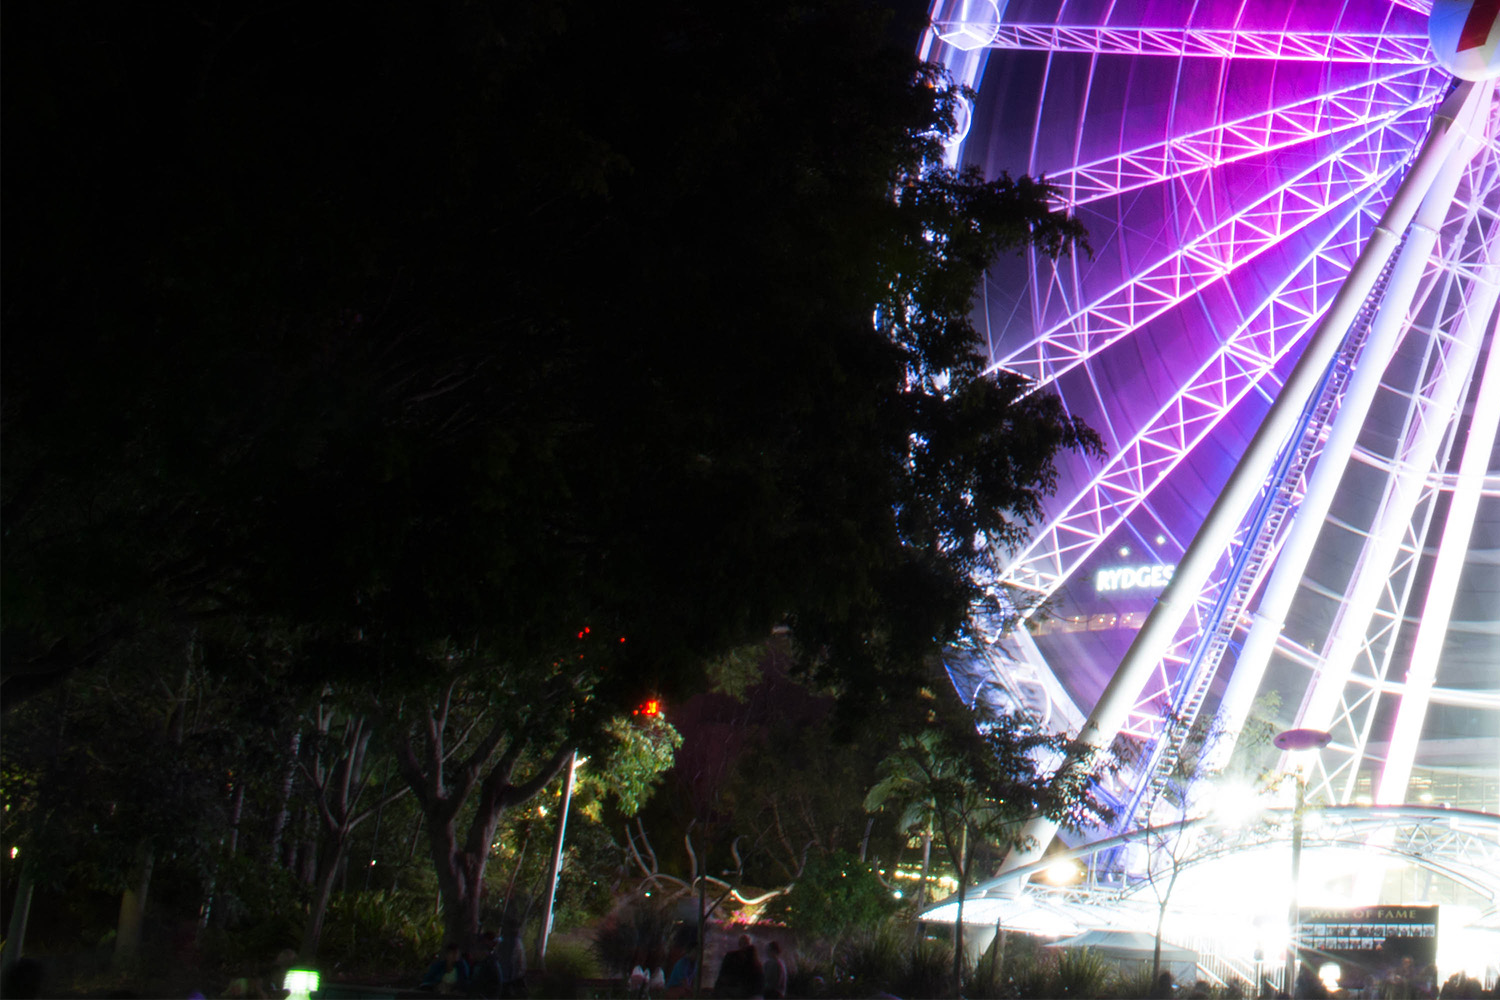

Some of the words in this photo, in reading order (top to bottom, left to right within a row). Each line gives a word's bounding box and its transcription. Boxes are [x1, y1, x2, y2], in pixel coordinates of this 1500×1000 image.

[1096, 565, 1175, 591] RYDGES
[1310, 909, 1348, 920] WALL
[1353, 909, 1373, 919] OF
[1377, 909, 1417, 919] FAME
